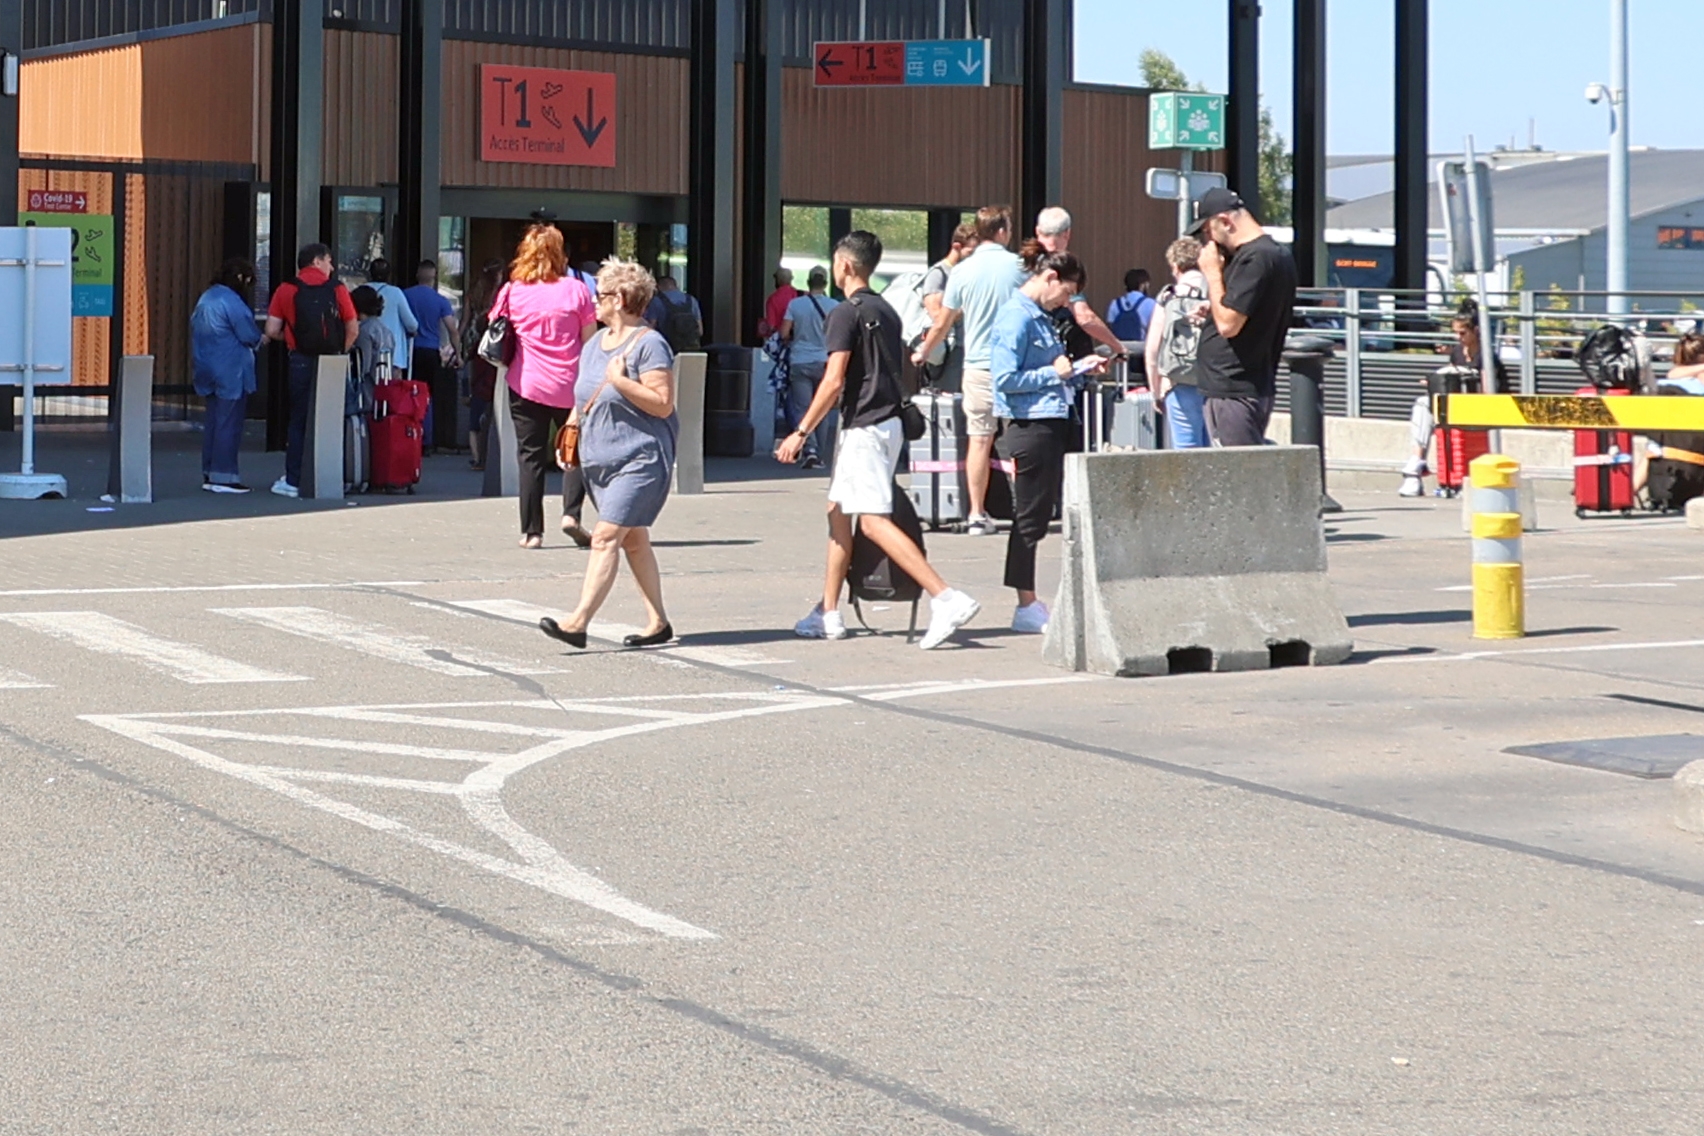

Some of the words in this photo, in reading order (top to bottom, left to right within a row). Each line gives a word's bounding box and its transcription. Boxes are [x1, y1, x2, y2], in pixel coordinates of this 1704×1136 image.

[852, 46, 878, 71] T1
[492, 76, 532, 129] T1
[522, 136, 565, 153] Terminal
[43, 192, 74, 203] Covid-19
